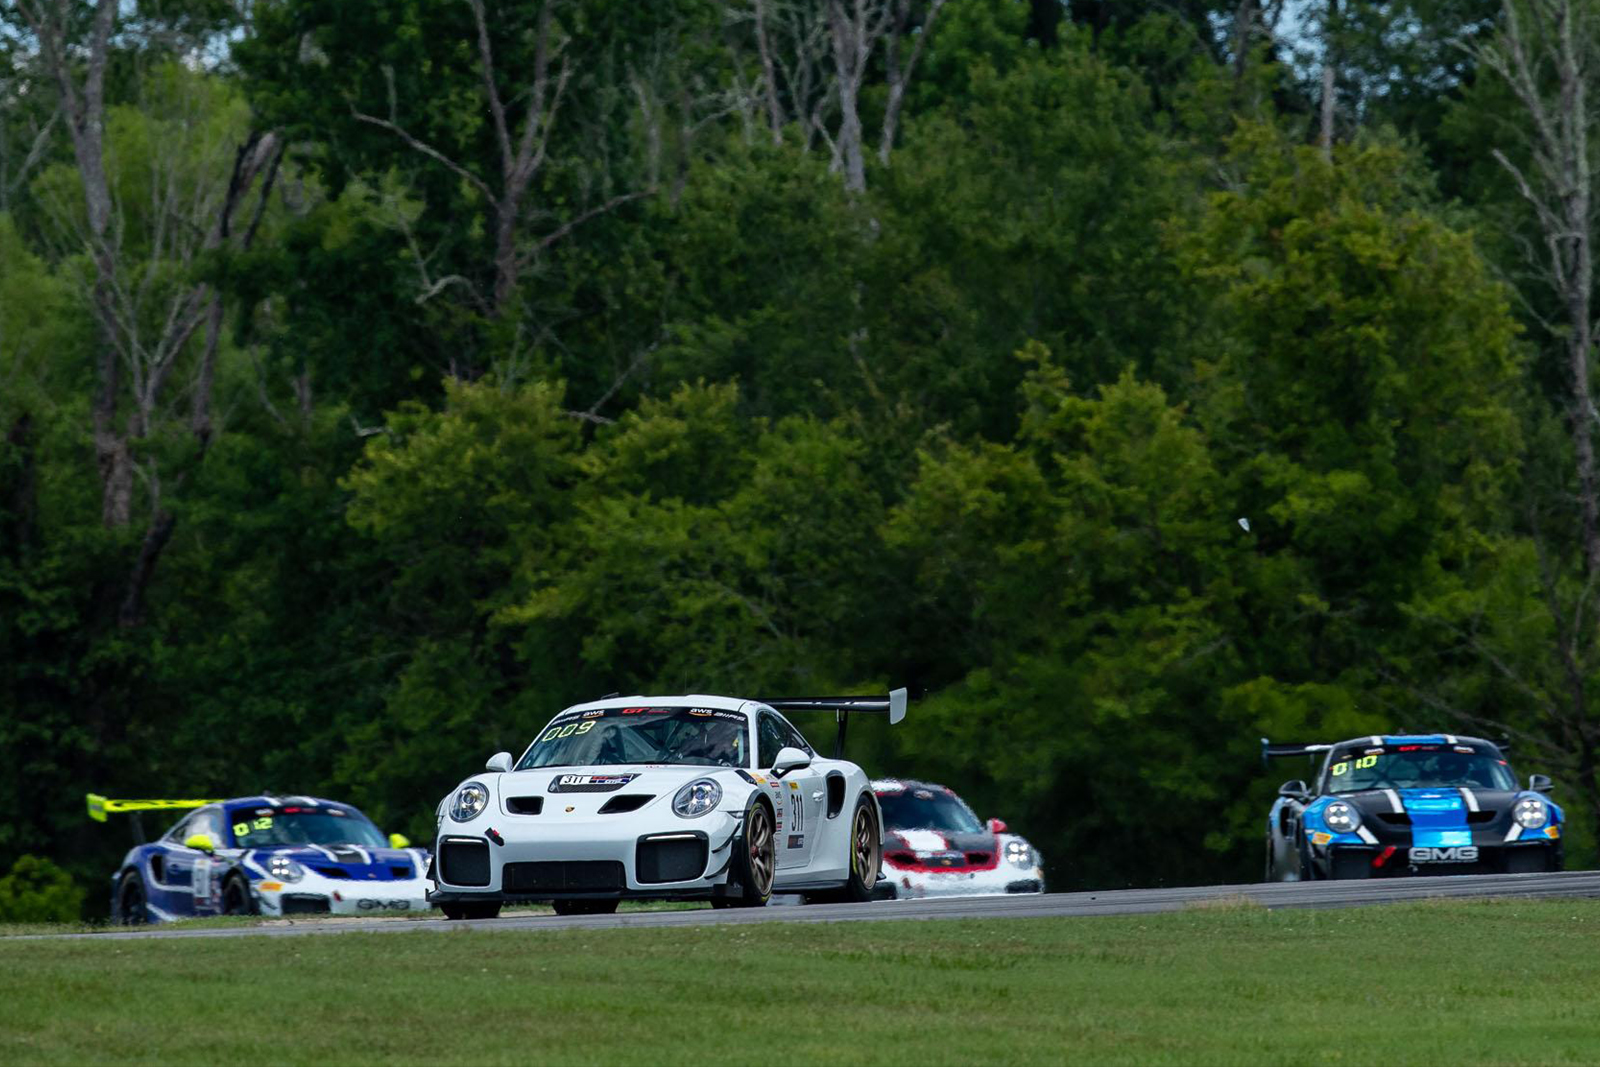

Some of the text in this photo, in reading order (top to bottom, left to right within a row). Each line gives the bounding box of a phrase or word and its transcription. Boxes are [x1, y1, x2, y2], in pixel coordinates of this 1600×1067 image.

[583, 709, 605, 717] aws
[689, 708, 713, 716] aws
[542, 720, 596, 741] 009
[1408, 846, 1479, 861] GMG
